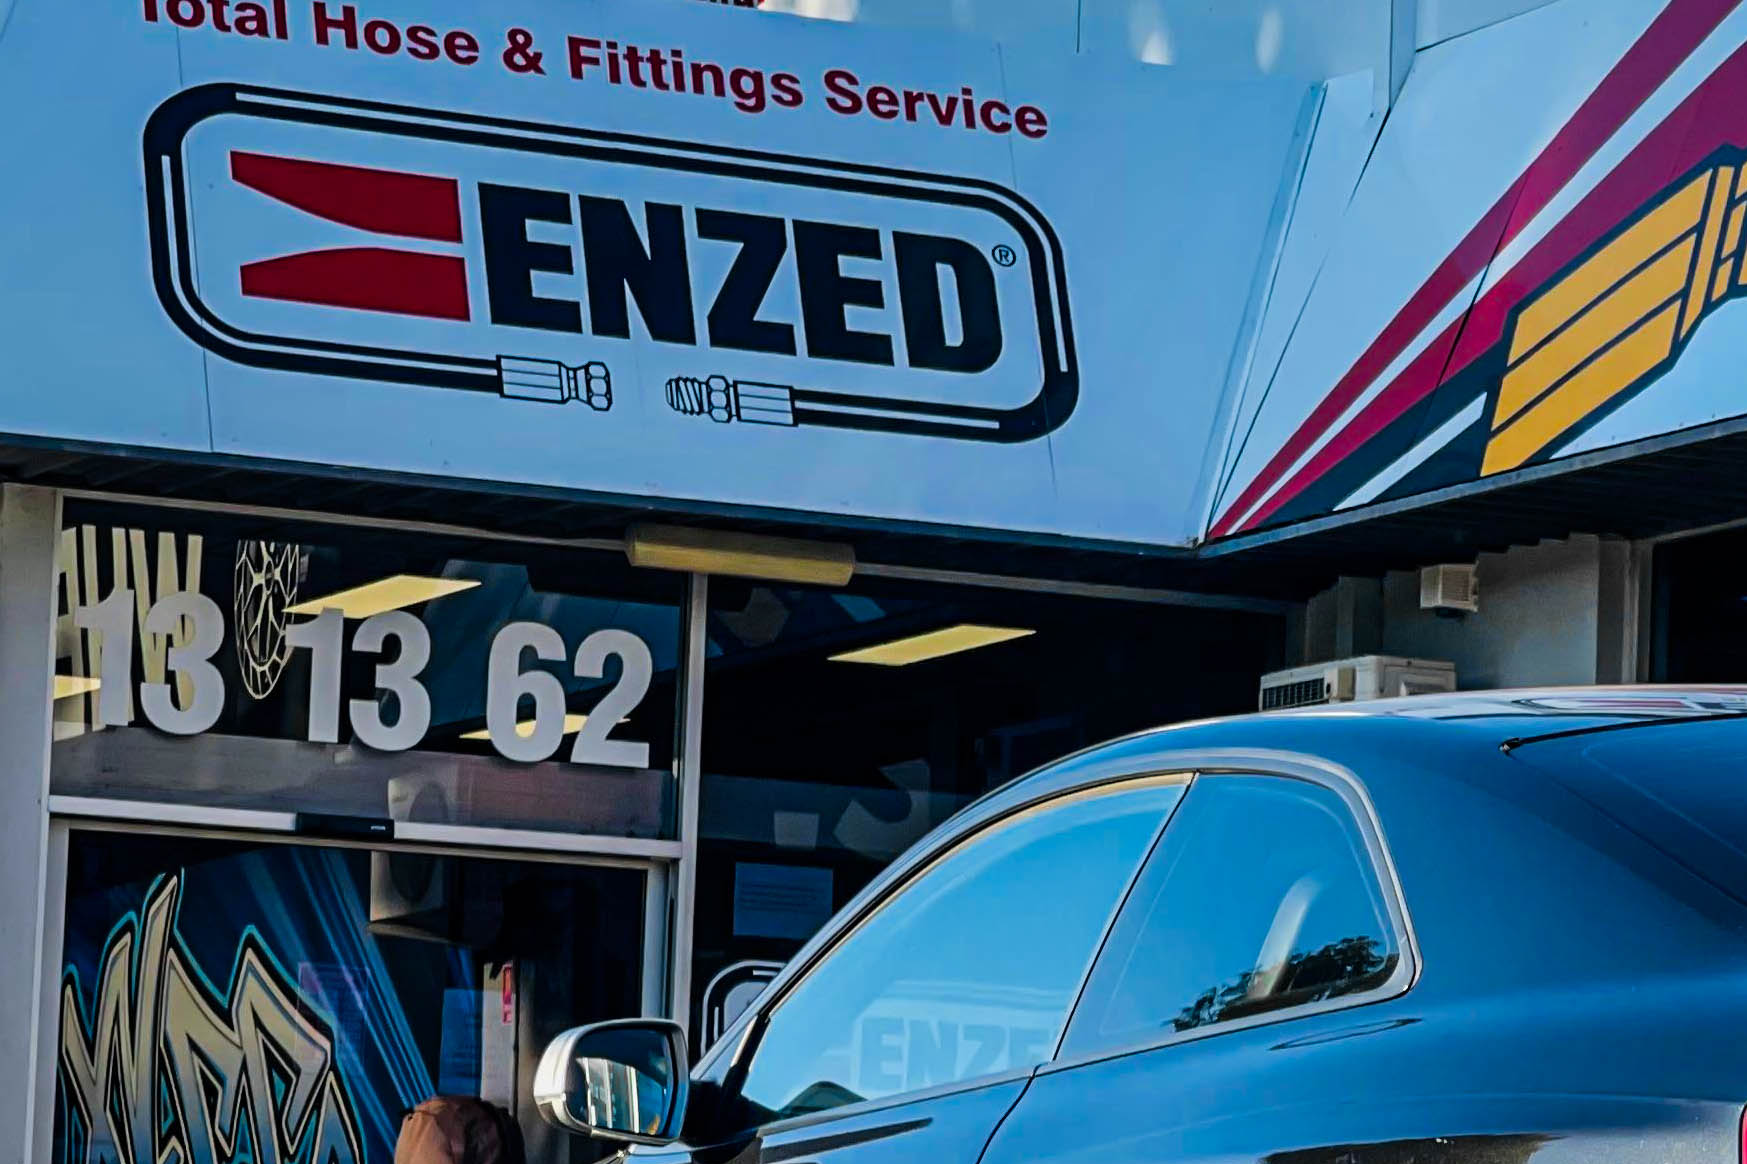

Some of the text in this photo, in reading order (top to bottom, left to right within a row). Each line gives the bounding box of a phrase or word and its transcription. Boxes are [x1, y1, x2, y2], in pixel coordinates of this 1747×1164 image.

[313, 2, 480, 65] Hose
[503, 28, 547, 75] &
[568, 36, 804, 113] Fittings
[823, 69, 1048, 138] Service
[478, 182, 1003, 374] ENZED
[76, 589, 652, 769] 13 13 62
